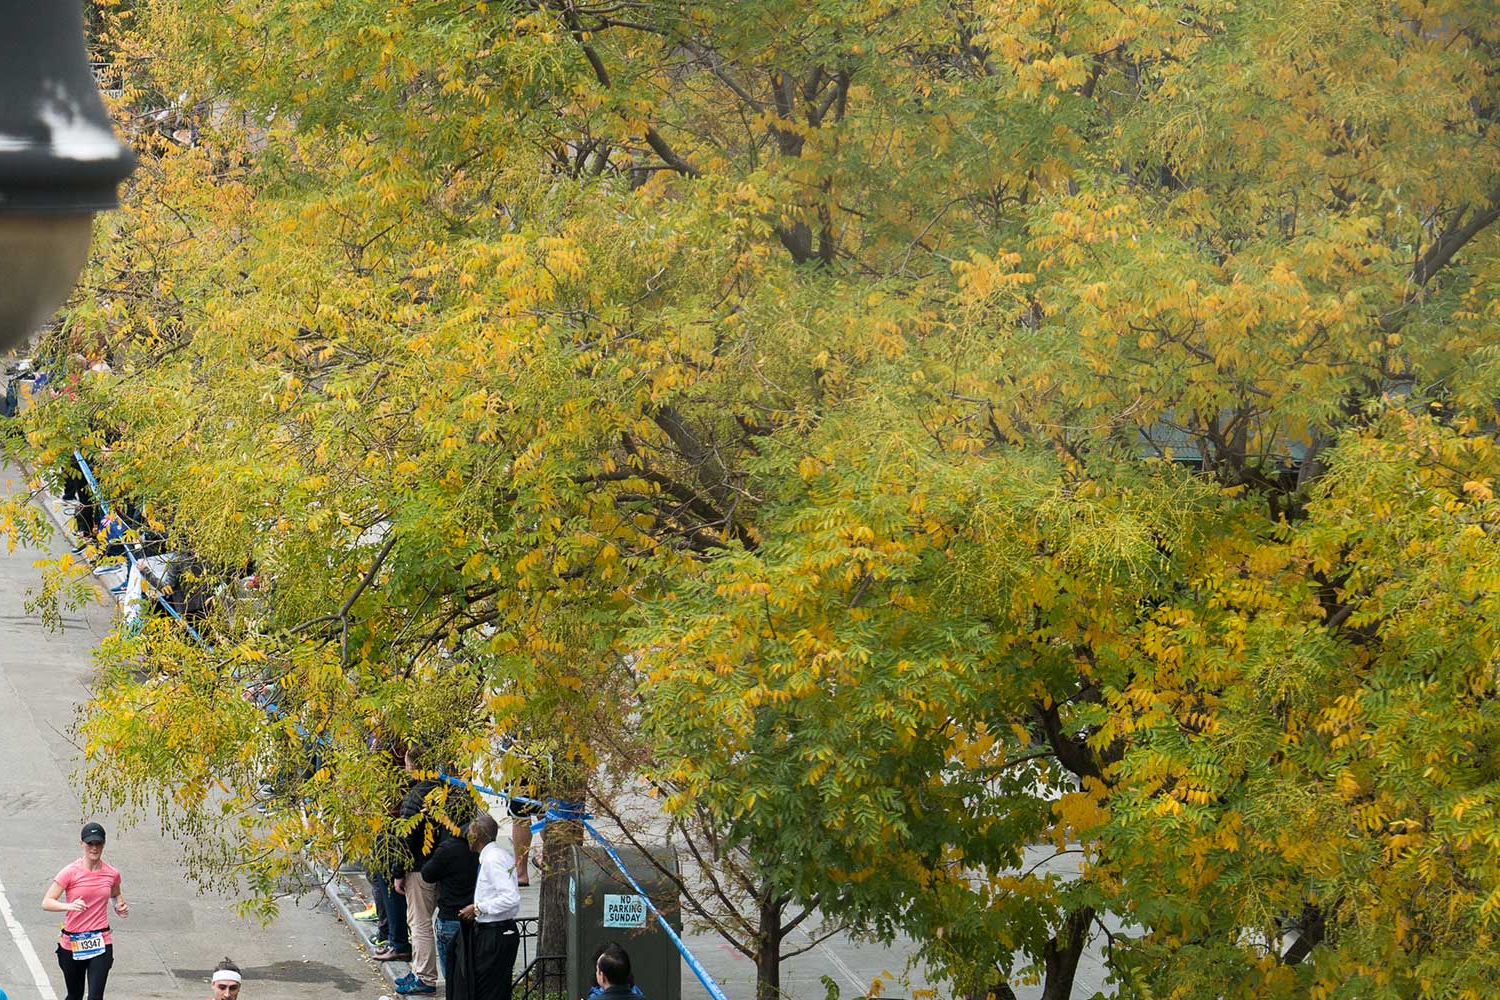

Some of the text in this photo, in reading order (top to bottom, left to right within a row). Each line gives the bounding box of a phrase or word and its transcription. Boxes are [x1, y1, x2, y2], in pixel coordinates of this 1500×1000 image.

[620, 896, 632, 904] NO
[608, 904, 642, 913] PARKING
[609, 913, 641, 922] SUNDAY
[80, 938, 101, 950] 13347
